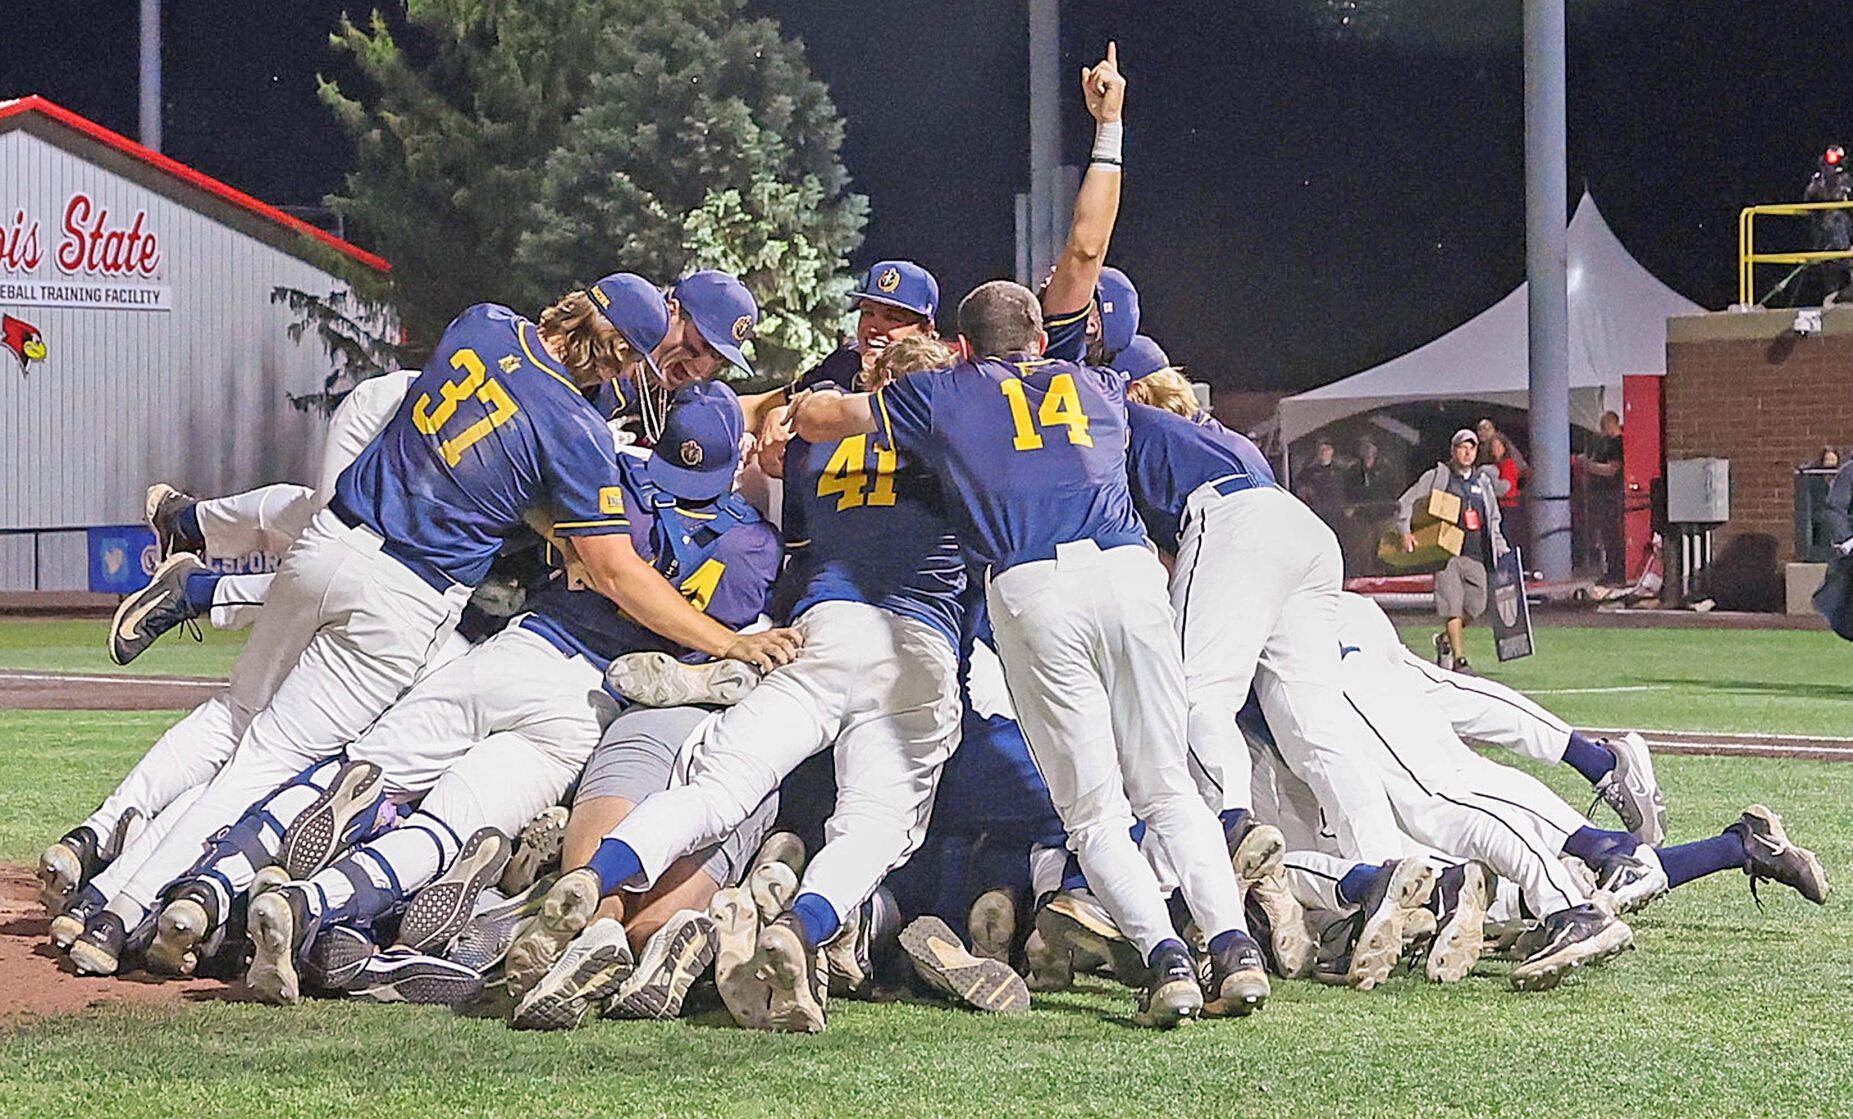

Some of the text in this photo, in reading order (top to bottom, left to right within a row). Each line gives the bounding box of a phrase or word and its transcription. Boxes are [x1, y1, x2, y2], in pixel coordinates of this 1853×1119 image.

[58, 195, 161, 274] State
[40, 285, 102, 302] TRAINING
[105, 287, 161, 304] FACILITY
[412, 348, 520, 468] 37
[1000, 373, 1094, 451] 14
[816, 433, 897, 512] 41
